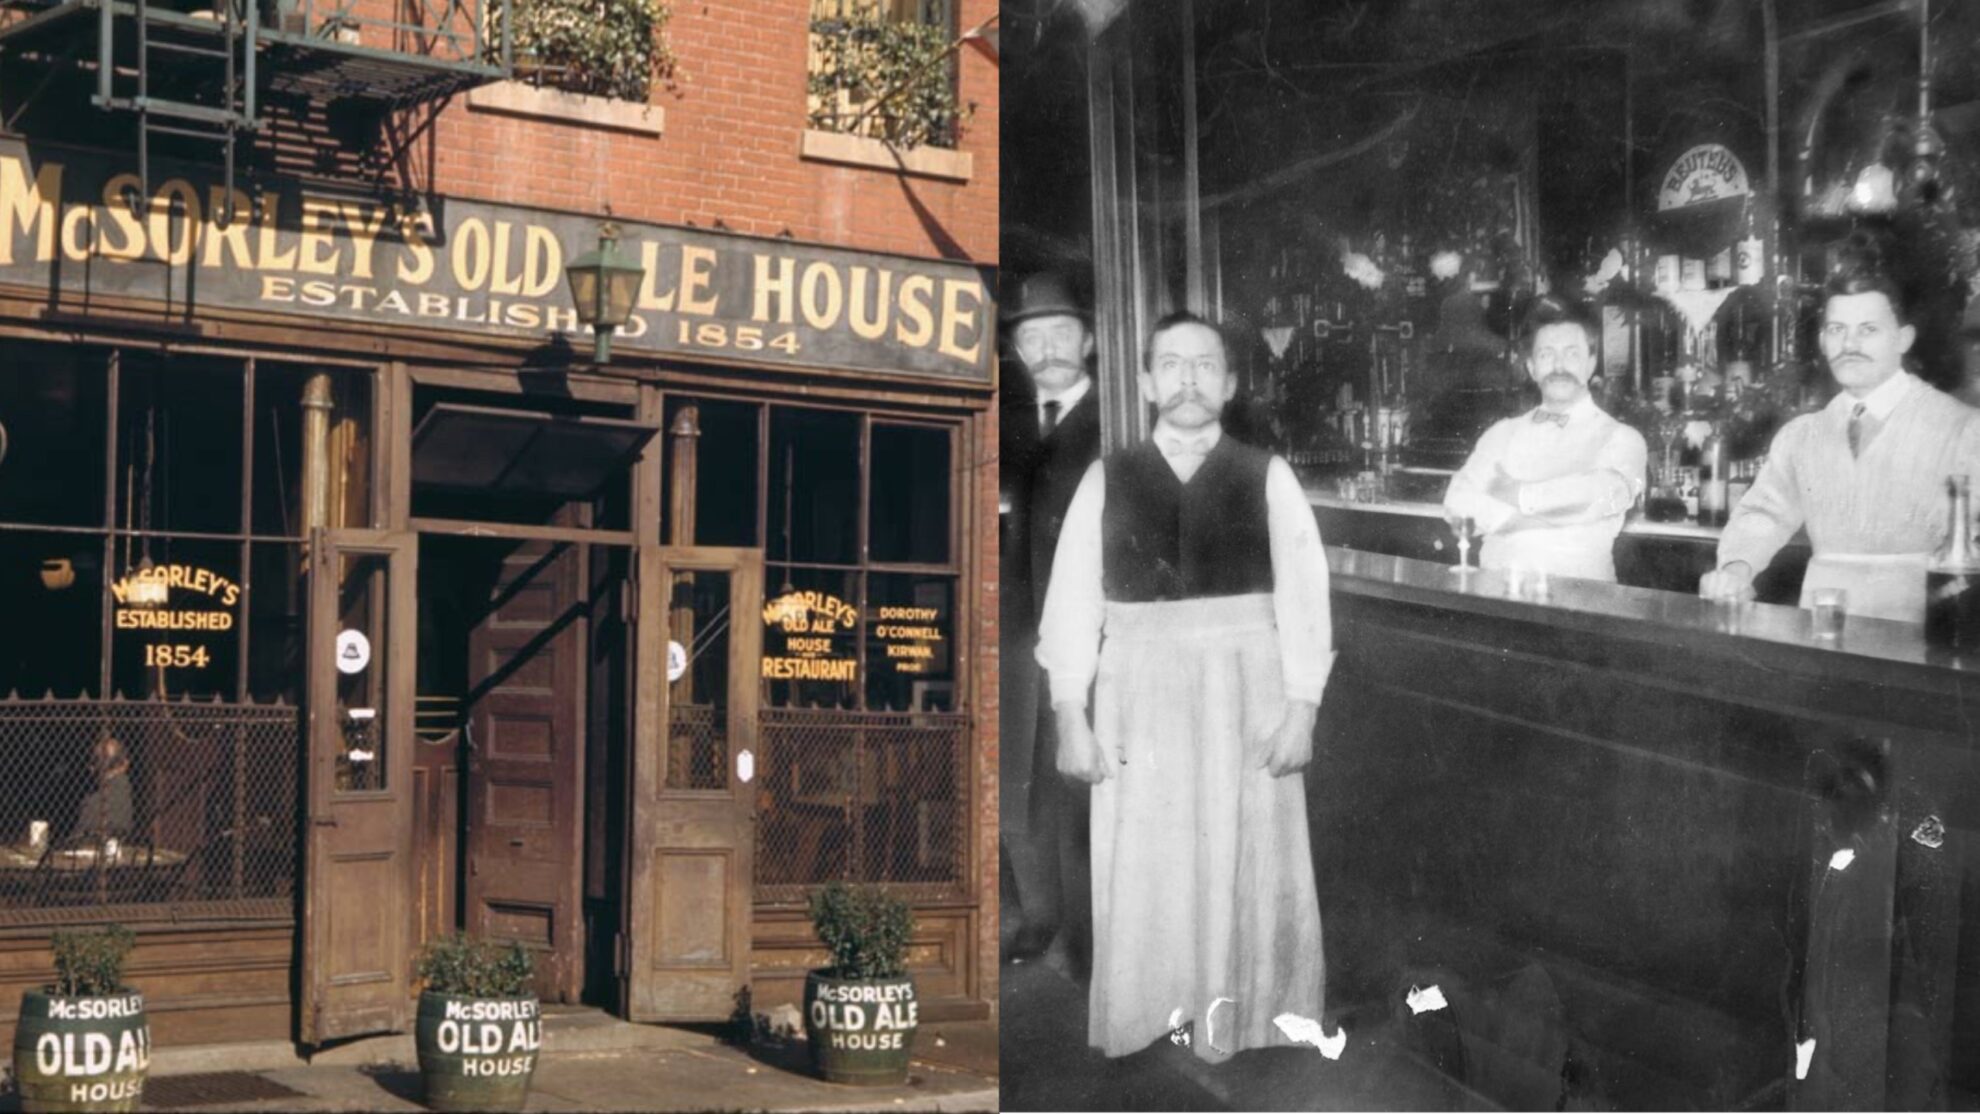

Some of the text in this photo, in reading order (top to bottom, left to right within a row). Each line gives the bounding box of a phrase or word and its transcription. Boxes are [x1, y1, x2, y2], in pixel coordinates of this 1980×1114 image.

[452, 217, 562, 298] OLD
[585, 240, 719, 316] LE
[752, 254, 982, 364] HOUSE
[260, 275, 801, 354] ESTABLISHD 1854
[116, 609, 233, 630] ESTABLISHED
[782, 615, 835, 633] OLD ALE
[880, 607, 938, 621] DOROTHY
[145, 644, 210, 668] 1854
[787, 637, 832, 653] HOUSE
[761, 657, 857, 680] RESTAURANT
[445, 1000, 541, 1021] McSORLEY
[811, 1001, 918, 1032] OLD ALE
[437, 1021, 503, 1054] OLD
[832, 1032, 903, 1050] HOUSE
[36, 1033, 112, 1077] OLD
[463, 1056, 532, 1077] HOUSE
